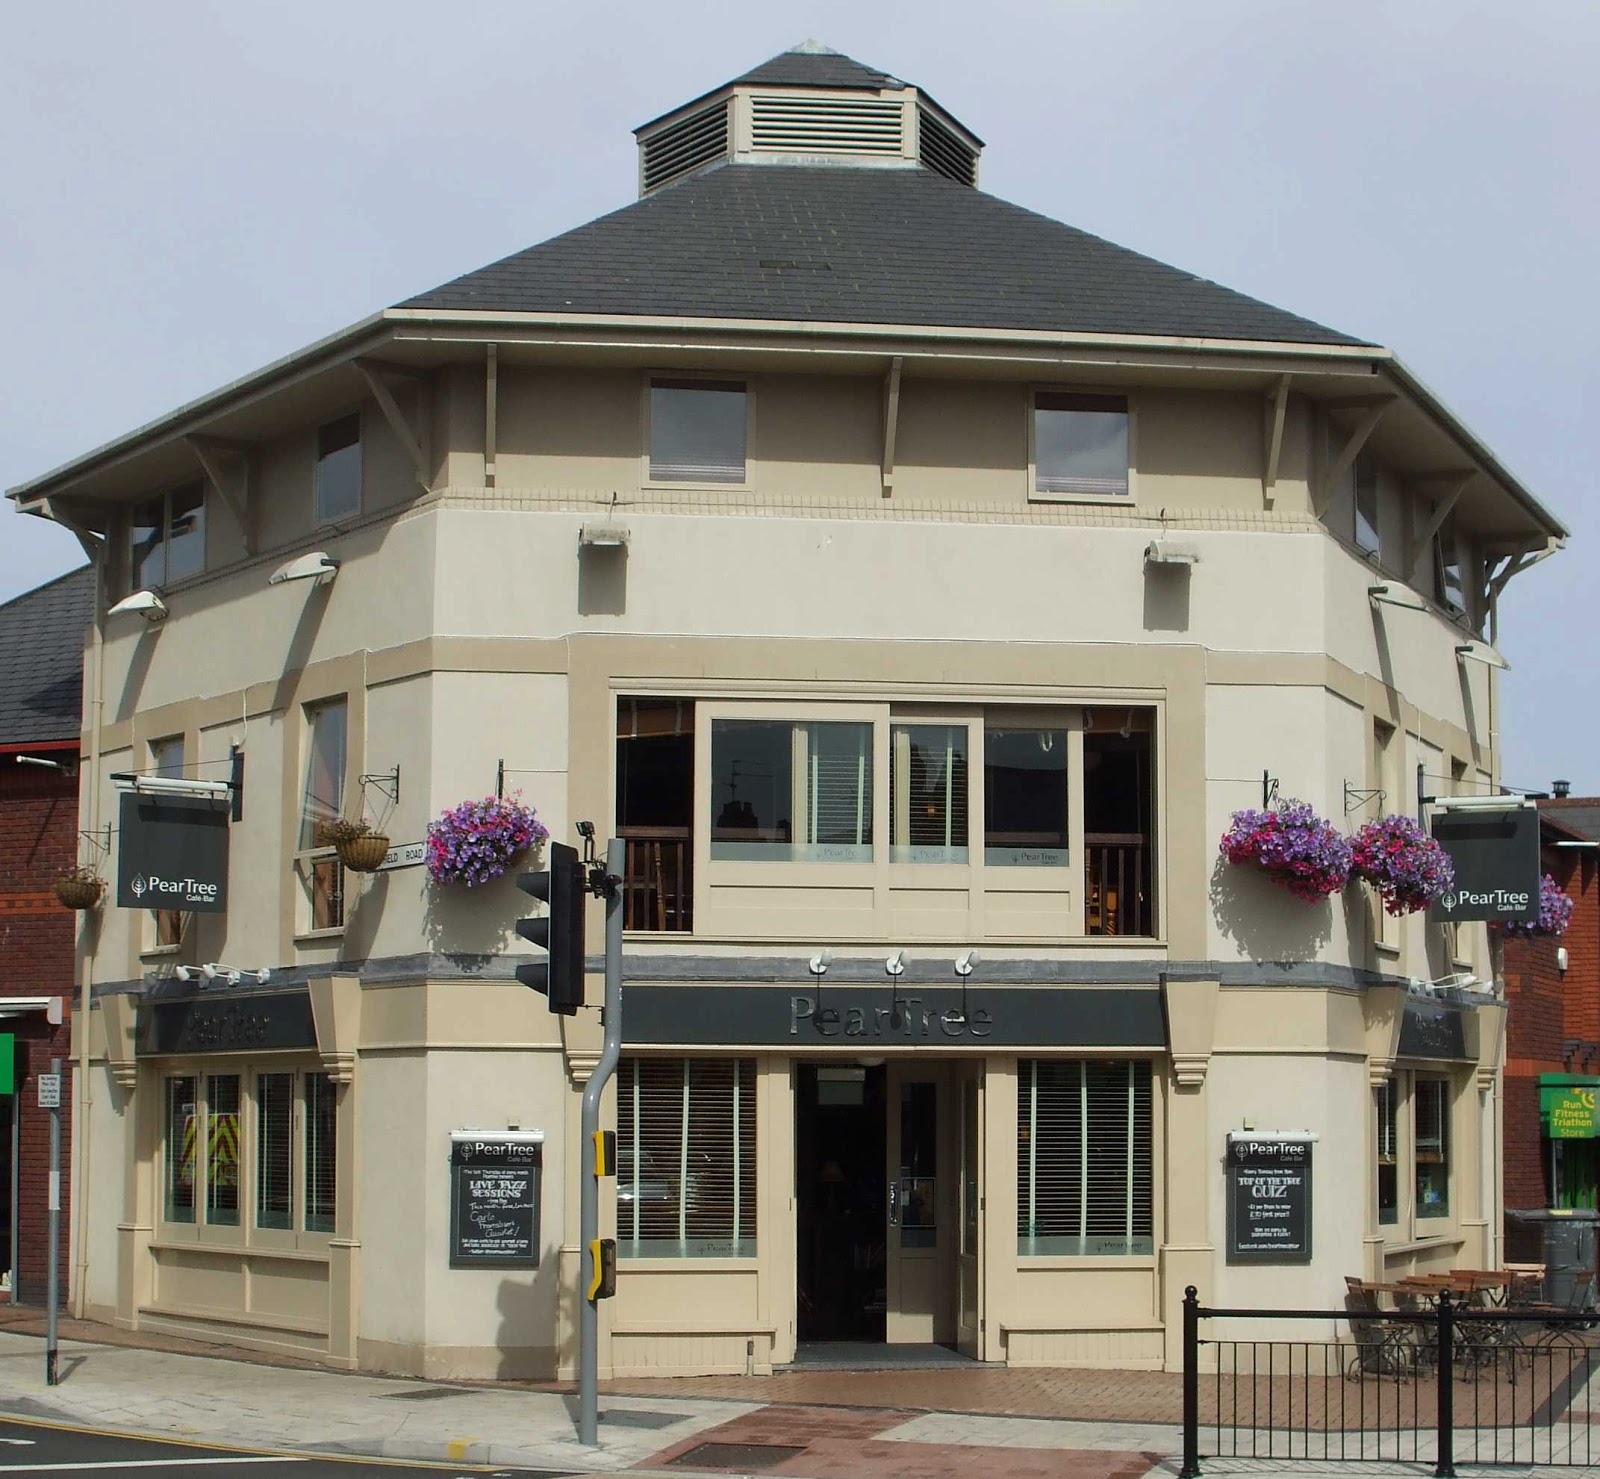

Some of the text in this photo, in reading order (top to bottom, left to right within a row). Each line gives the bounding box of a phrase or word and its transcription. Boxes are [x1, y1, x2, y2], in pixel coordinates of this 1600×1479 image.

[406, 849, 423, 860] ROAD
[149, 876, 217, 895] PearTree
[1459, 889, 1529, 905] PearTree
[790, 997, 993, 1036] PearTree
[1563, 1100, 1582, 1109] Run
[1555, 1109, 1590, 1118] Fitness
[1560, 1128, 1585, 1137] Store
[475, 1142, 534, 1156] PearTree
[1249, 1142, 1305, 1155] PearTree
[469, 1180, 527, 1190] LIVE JAZZ
[472, 1189, 521, 1198] SESSIONS
[1252, 1185, 1287, 1198] QUIZ
